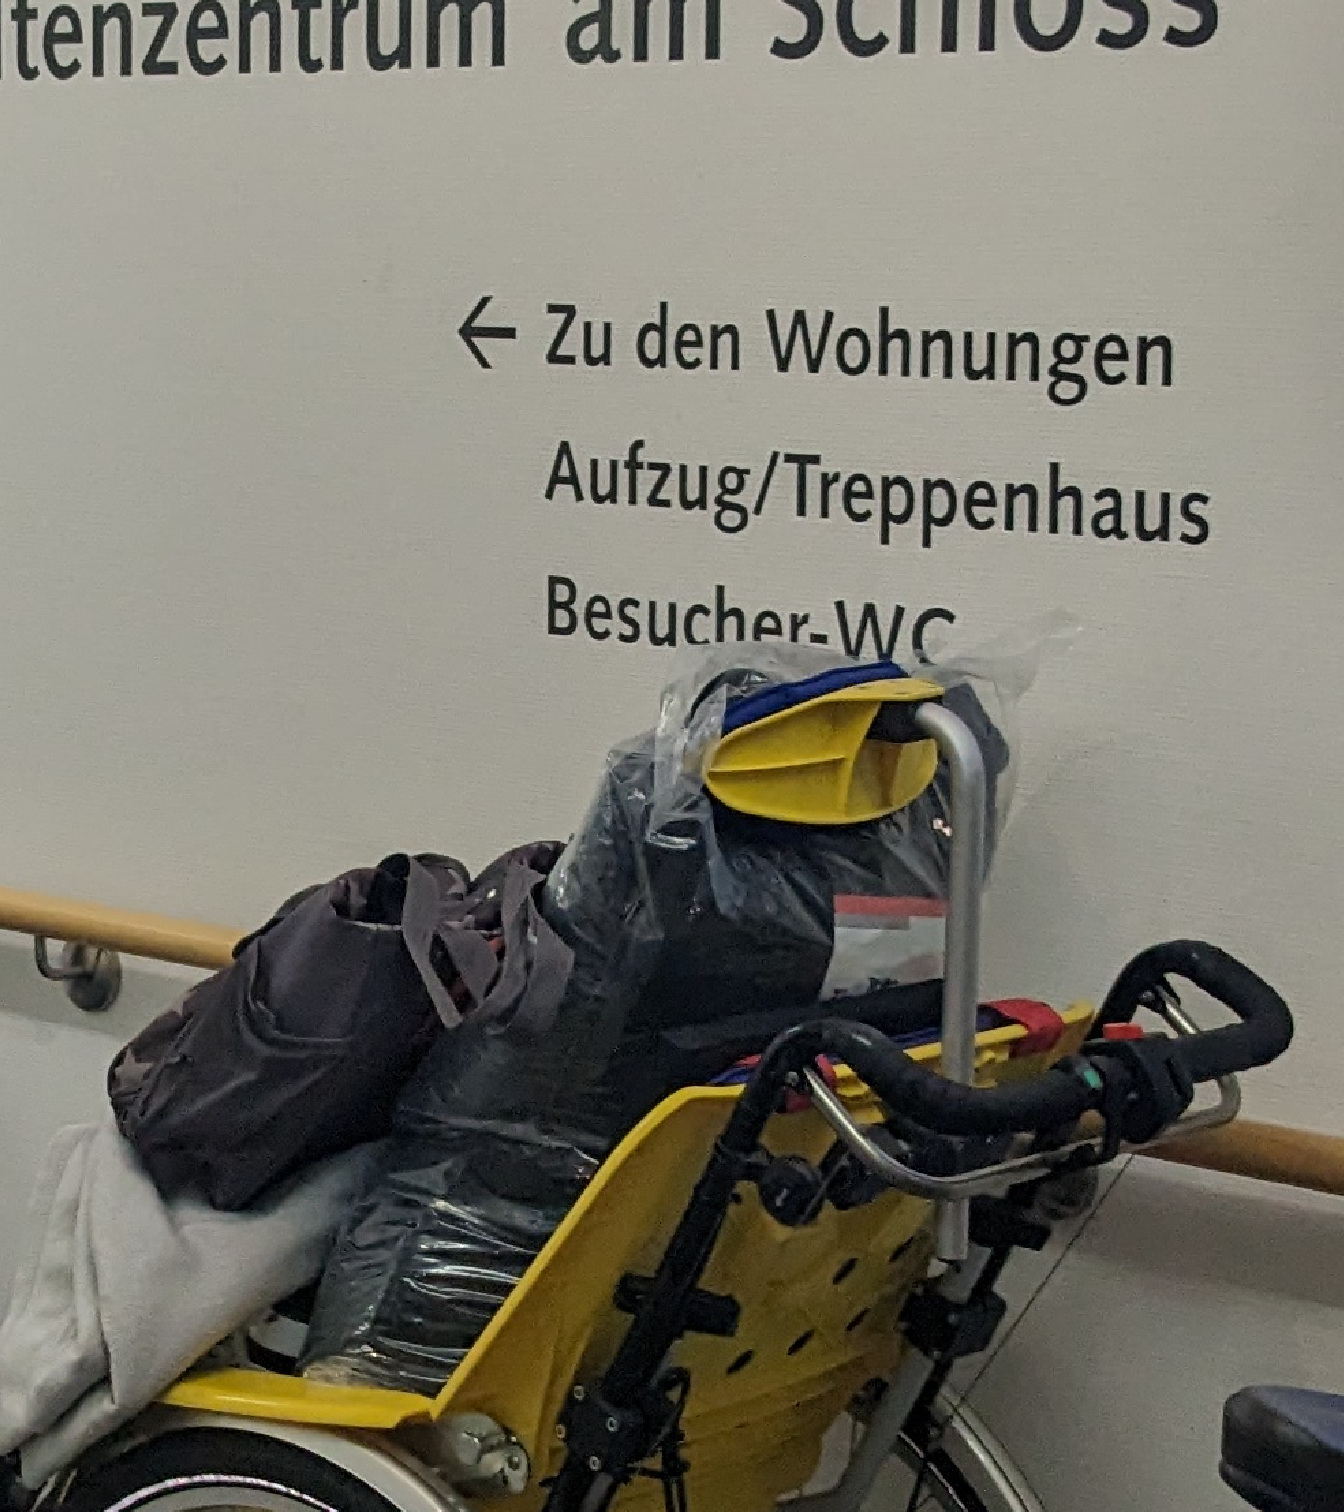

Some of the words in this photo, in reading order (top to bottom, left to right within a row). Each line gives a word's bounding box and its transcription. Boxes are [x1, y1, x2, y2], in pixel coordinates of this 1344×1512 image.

[545, 304, 611, 367] Zu
[636, 302, 740, 371] den
[766, 306, 1173, 407] Wohnungen
[544, 439, 1210, 548] Aufzug/Treppenhaus
[547, 575, 955, 664] Besucher-WC
